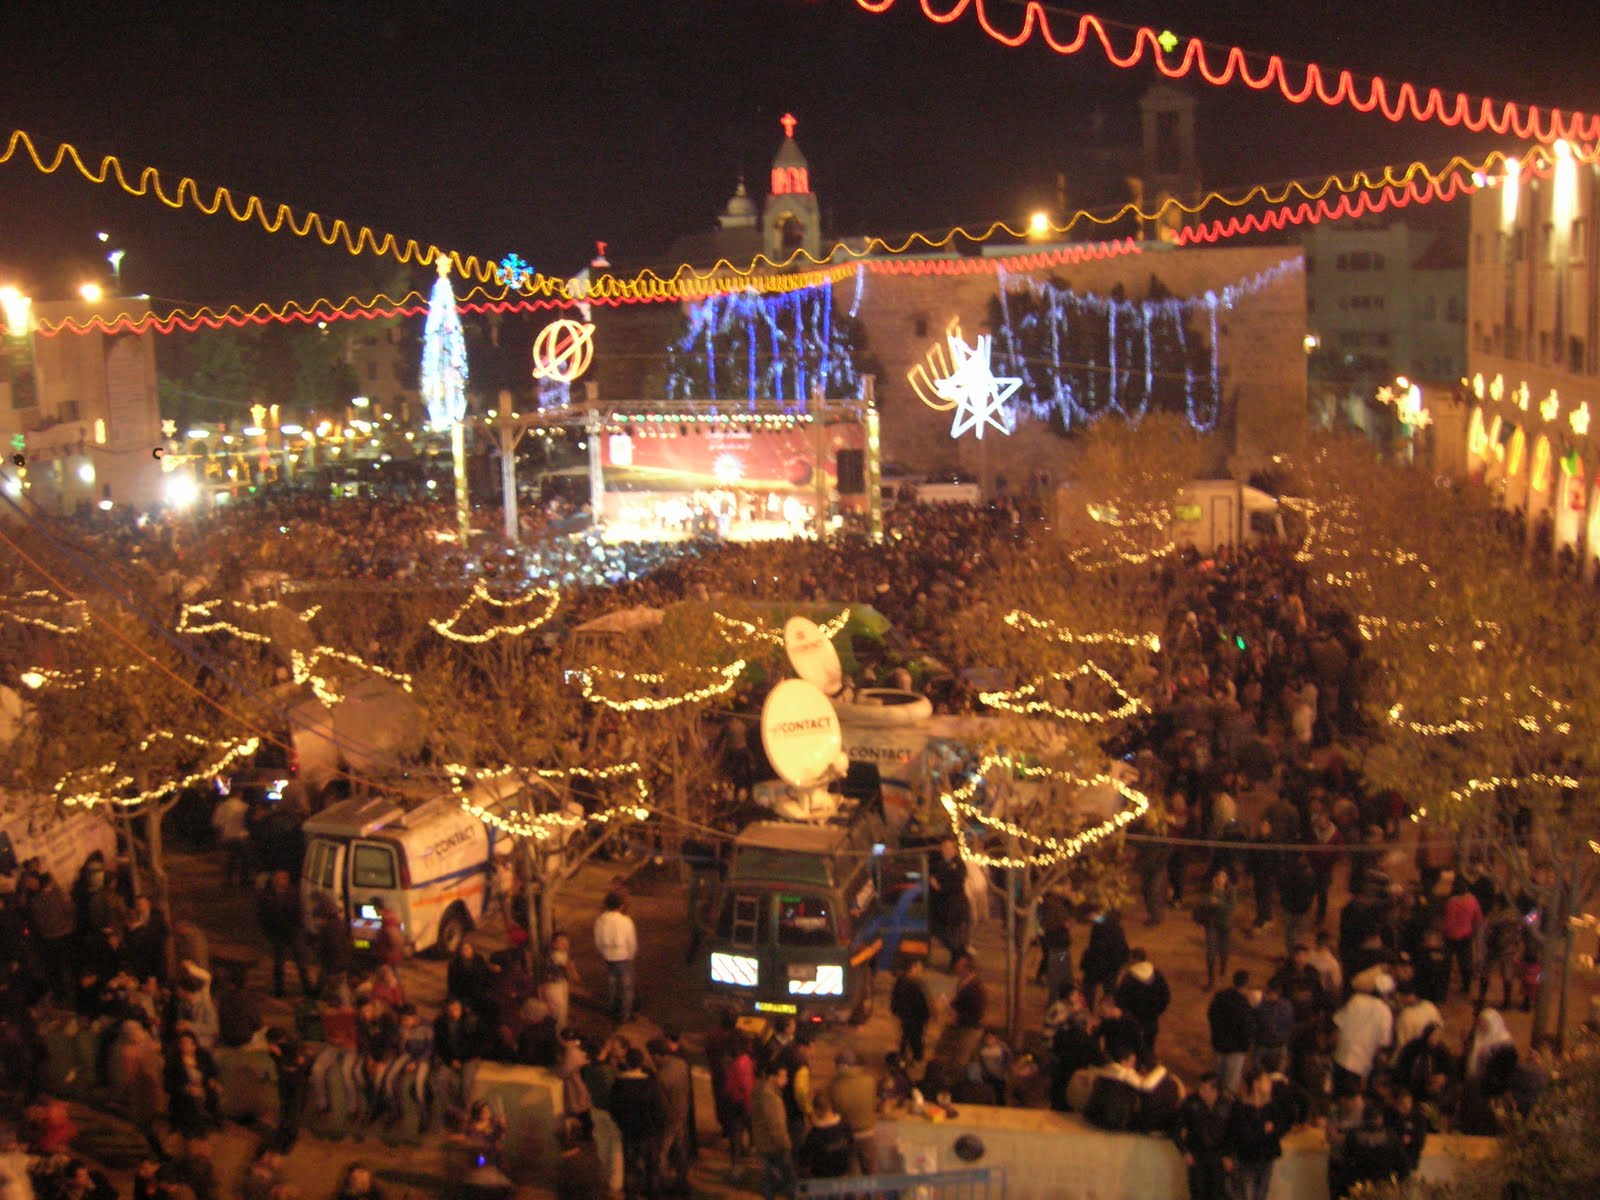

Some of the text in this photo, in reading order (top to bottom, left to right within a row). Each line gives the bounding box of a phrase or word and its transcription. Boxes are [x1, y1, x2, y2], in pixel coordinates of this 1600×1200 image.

[782, 717, 830, 733] CONTACT
[849, 747, 911, 761] CONTACT
[434, 826, 475, 856] CONTACT
